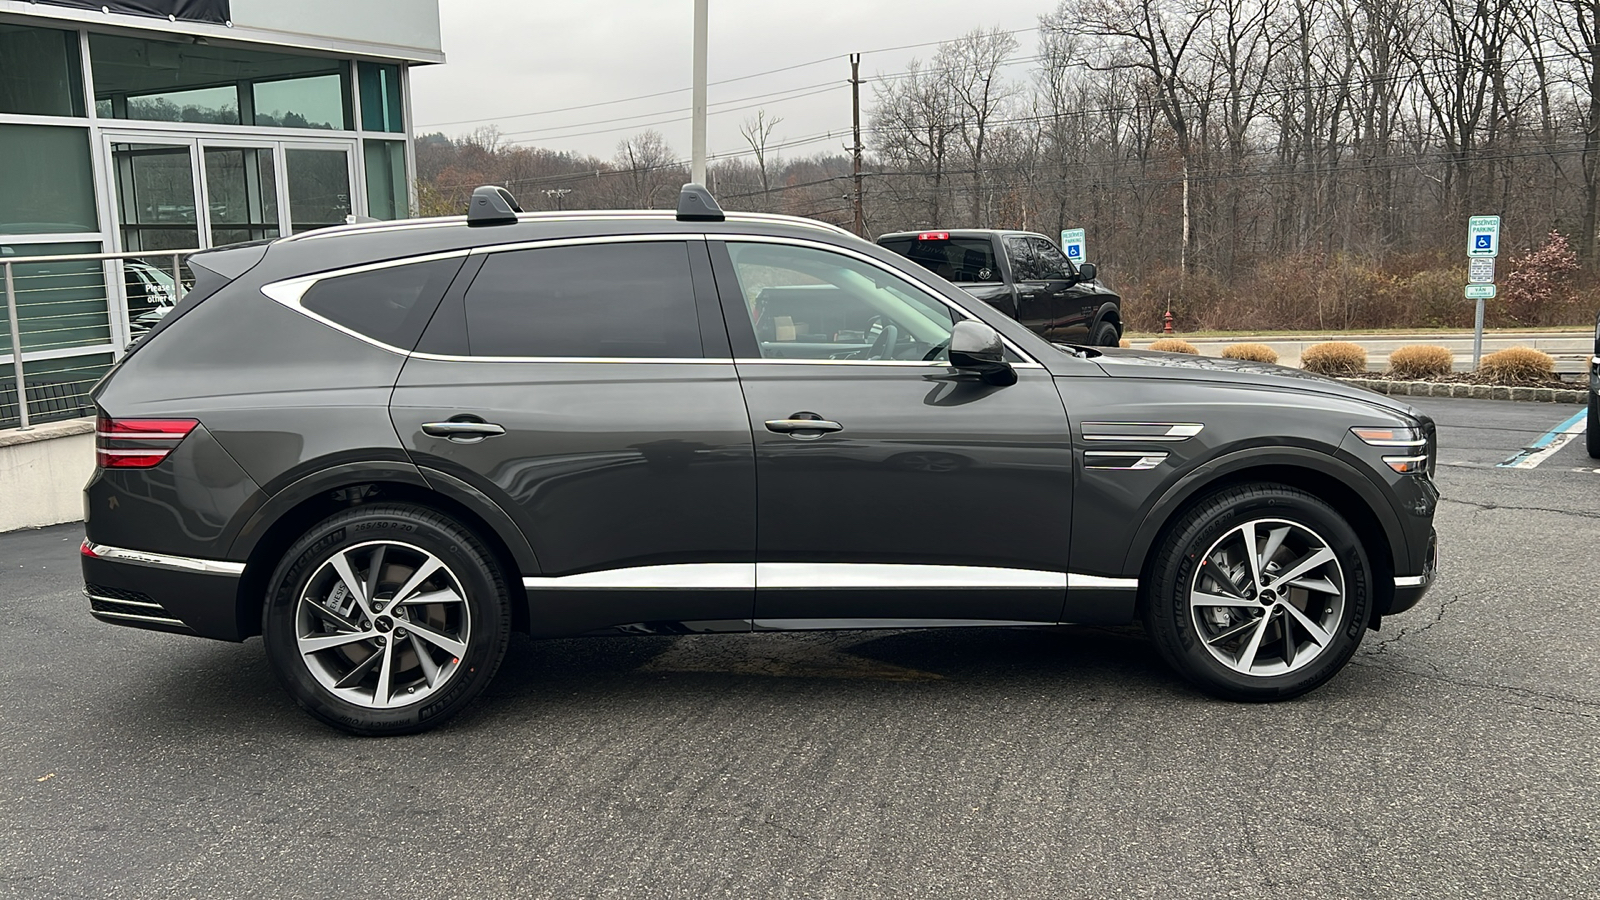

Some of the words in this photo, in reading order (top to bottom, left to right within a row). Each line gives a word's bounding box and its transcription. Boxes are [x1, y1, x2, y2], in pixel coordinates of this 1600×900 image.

[145, 284, 170, 293] Please
[147, 294, 168, 303] other
[355, 521, 389, 532] 265/50
[400, 523, 413, 532] 20
[1191, 526, 1213, 551] 265/50
[1222, 512, 1231, 521] 20
[285, 529, 344, 586] MICHELIN
[330, 584, 346, 610] ENESIS
[1174, 558, 1190, 628] MICHELIN
[1349, 570, 1365, 638] MICHELIN
[339, 715, 364, 726] TOUR
[369, 718, 411, 728] PRIMACY
